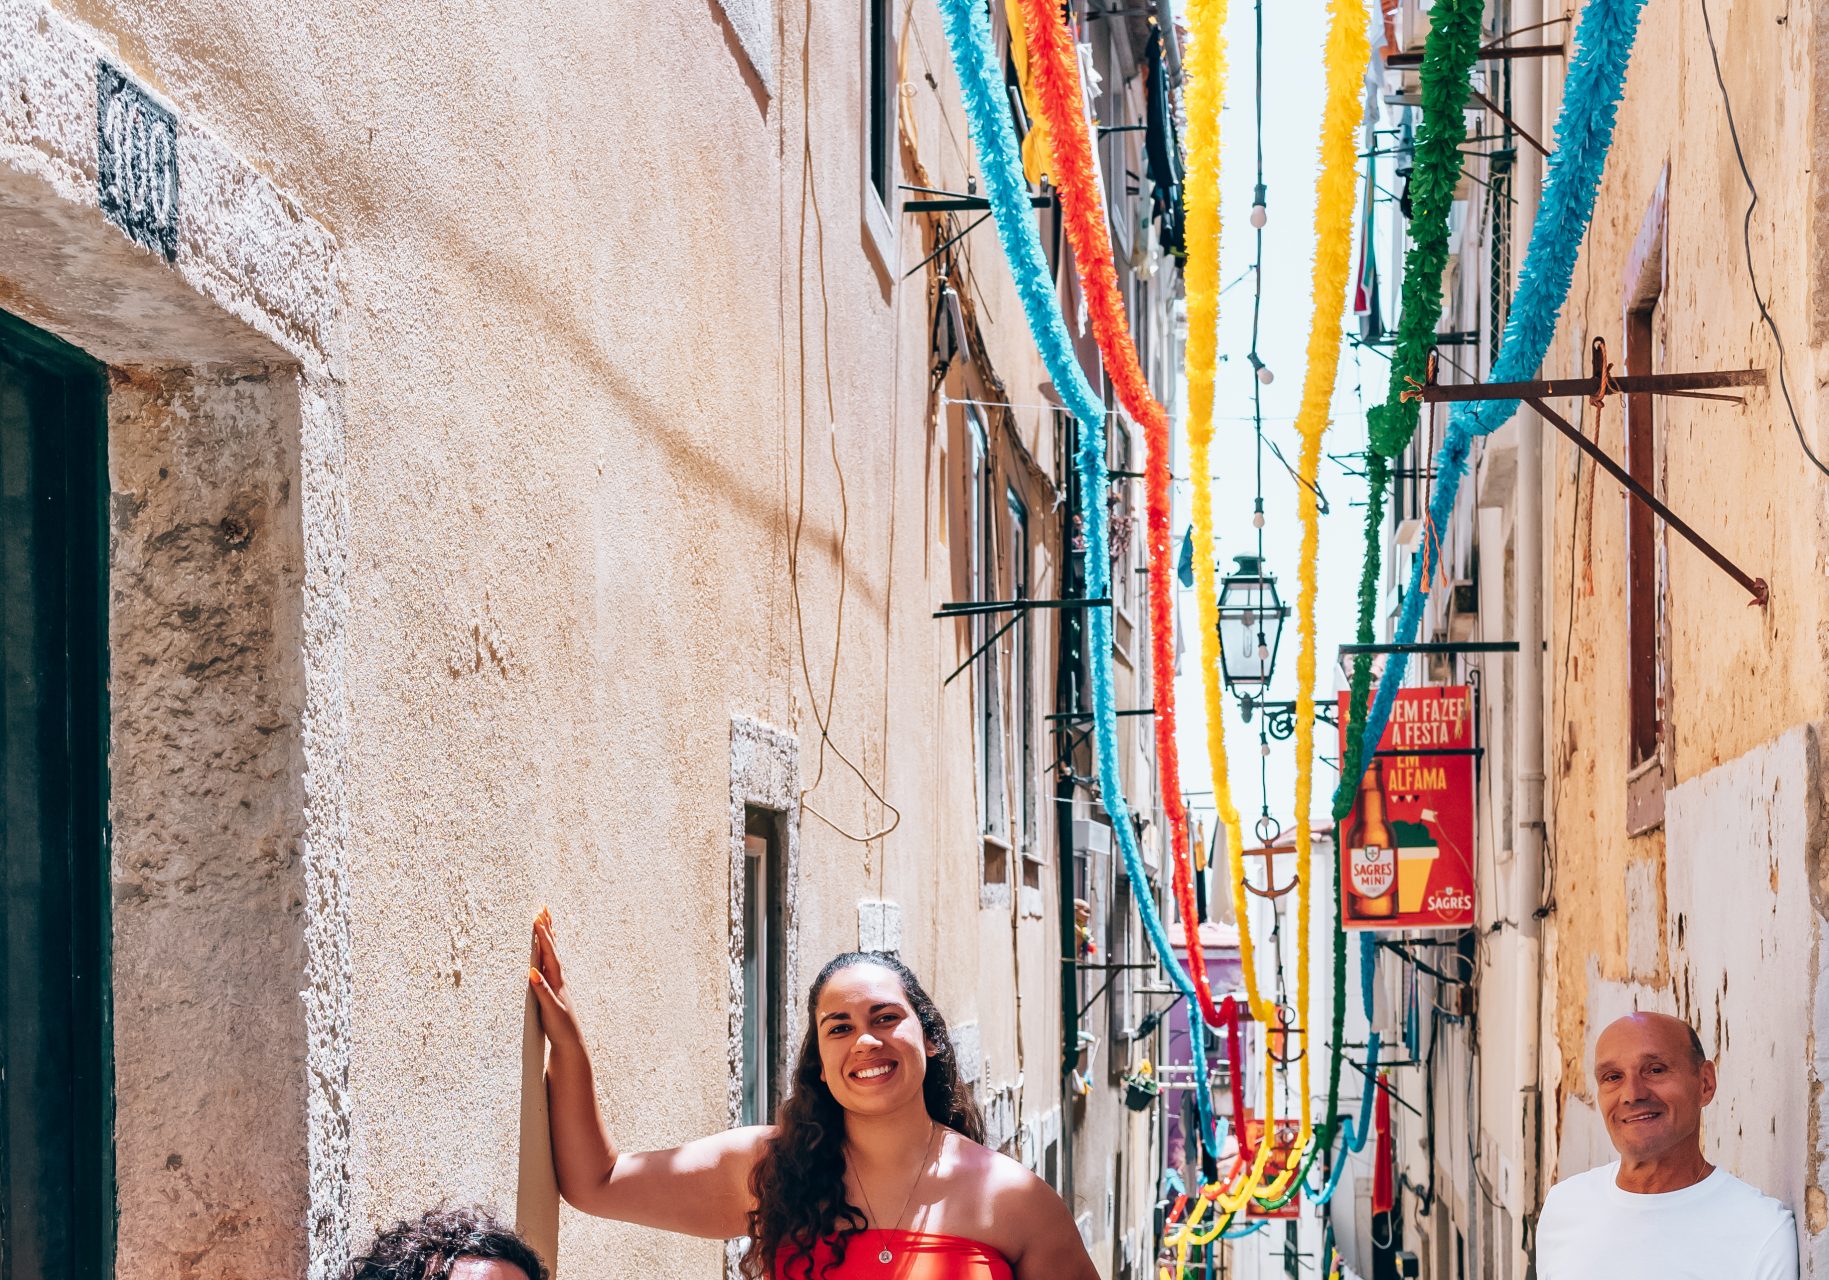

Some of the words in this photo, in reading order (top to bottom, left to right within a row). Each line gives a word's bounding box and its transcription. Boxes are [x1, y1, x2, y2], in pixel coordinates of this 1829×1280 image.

[1392, 723, 1401, 746] A
[1405, 721, 1449, 745] FESTA
[1397, 746, 1420, 768] EM
[1388, 767, 1447, 791] ALFAMA
[1354, 862, 1392, 877] SAGRES
[1427, 895, 1472, 911] SAGRES
